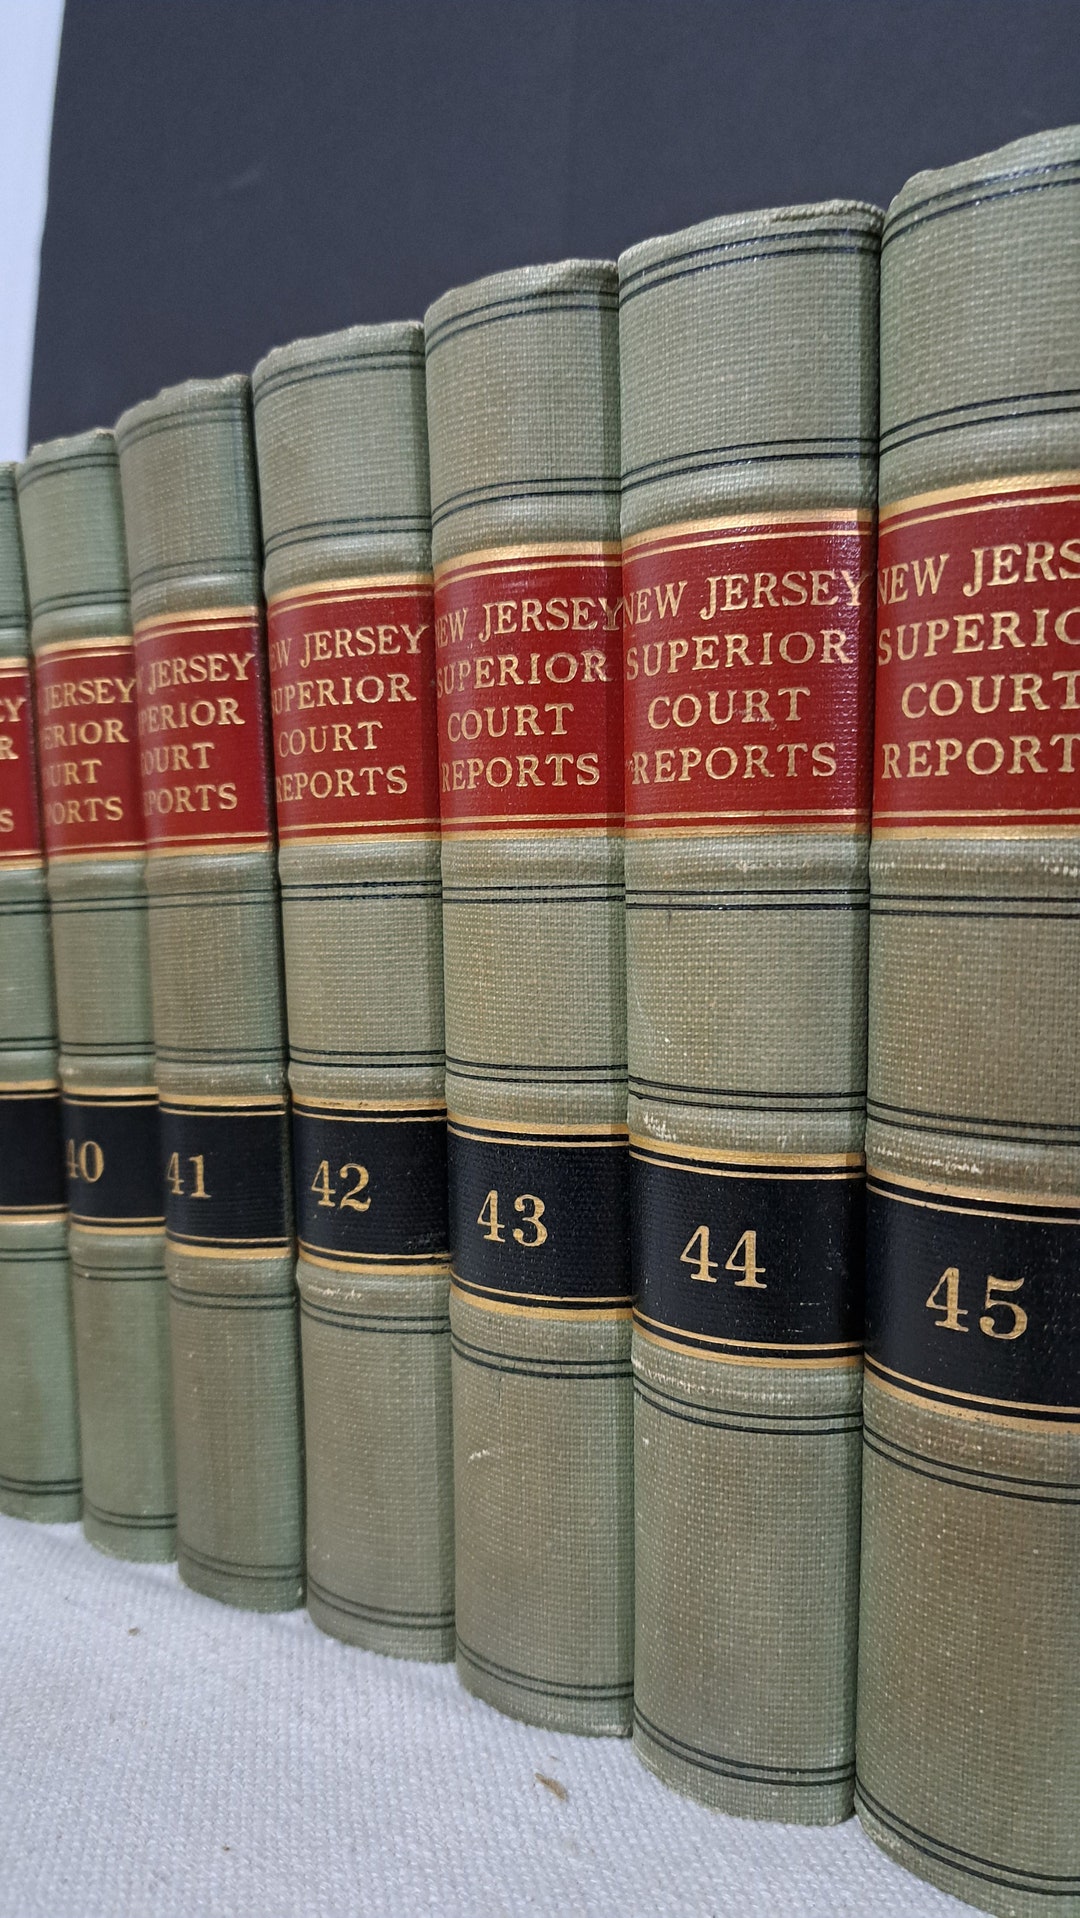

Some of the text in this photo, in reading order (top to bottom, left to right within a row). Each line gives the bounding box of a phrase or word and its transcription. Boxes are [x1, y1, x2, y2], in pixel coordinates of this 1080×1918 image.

[963, 538, 1080, 597] JERS
[478, 597, 623, 643] JERSEY
[622, 570, 869, 627] NEW JERSEY
[300, 623, 429, 668] JERSEY
[626, 629, 853, 680] SUPERIOR
[878, 606, 1080, 667] SUPERIO
[148, 653, 256, 695] JERSEY
[271, 673, 417, 715] UPERIOR
[437, 649, 615, 699] SUPERIOR
[901, 669, 1080, 719] COURT
[447, 703, 575, 742] COURT
[647, 687, 811, 730] COURT
[43, 719, 130, 750] ERIOR
[278, 721, 383, 757] COURT
[881, 733, 1080, 779] REPORT
[141, 742, 216, 776] OURT
[441, 752, 600, 792] REPORTS
[631, 742, 837, 785] REPORTS
[167, 1151, 212, 1198] 41
[310, 1159, 373, 1213] 42
[476, 1189, 549, 1248] 43
[680, 1225, 768, 1289] 44
[925, 1267, 1029, 1341] 45
